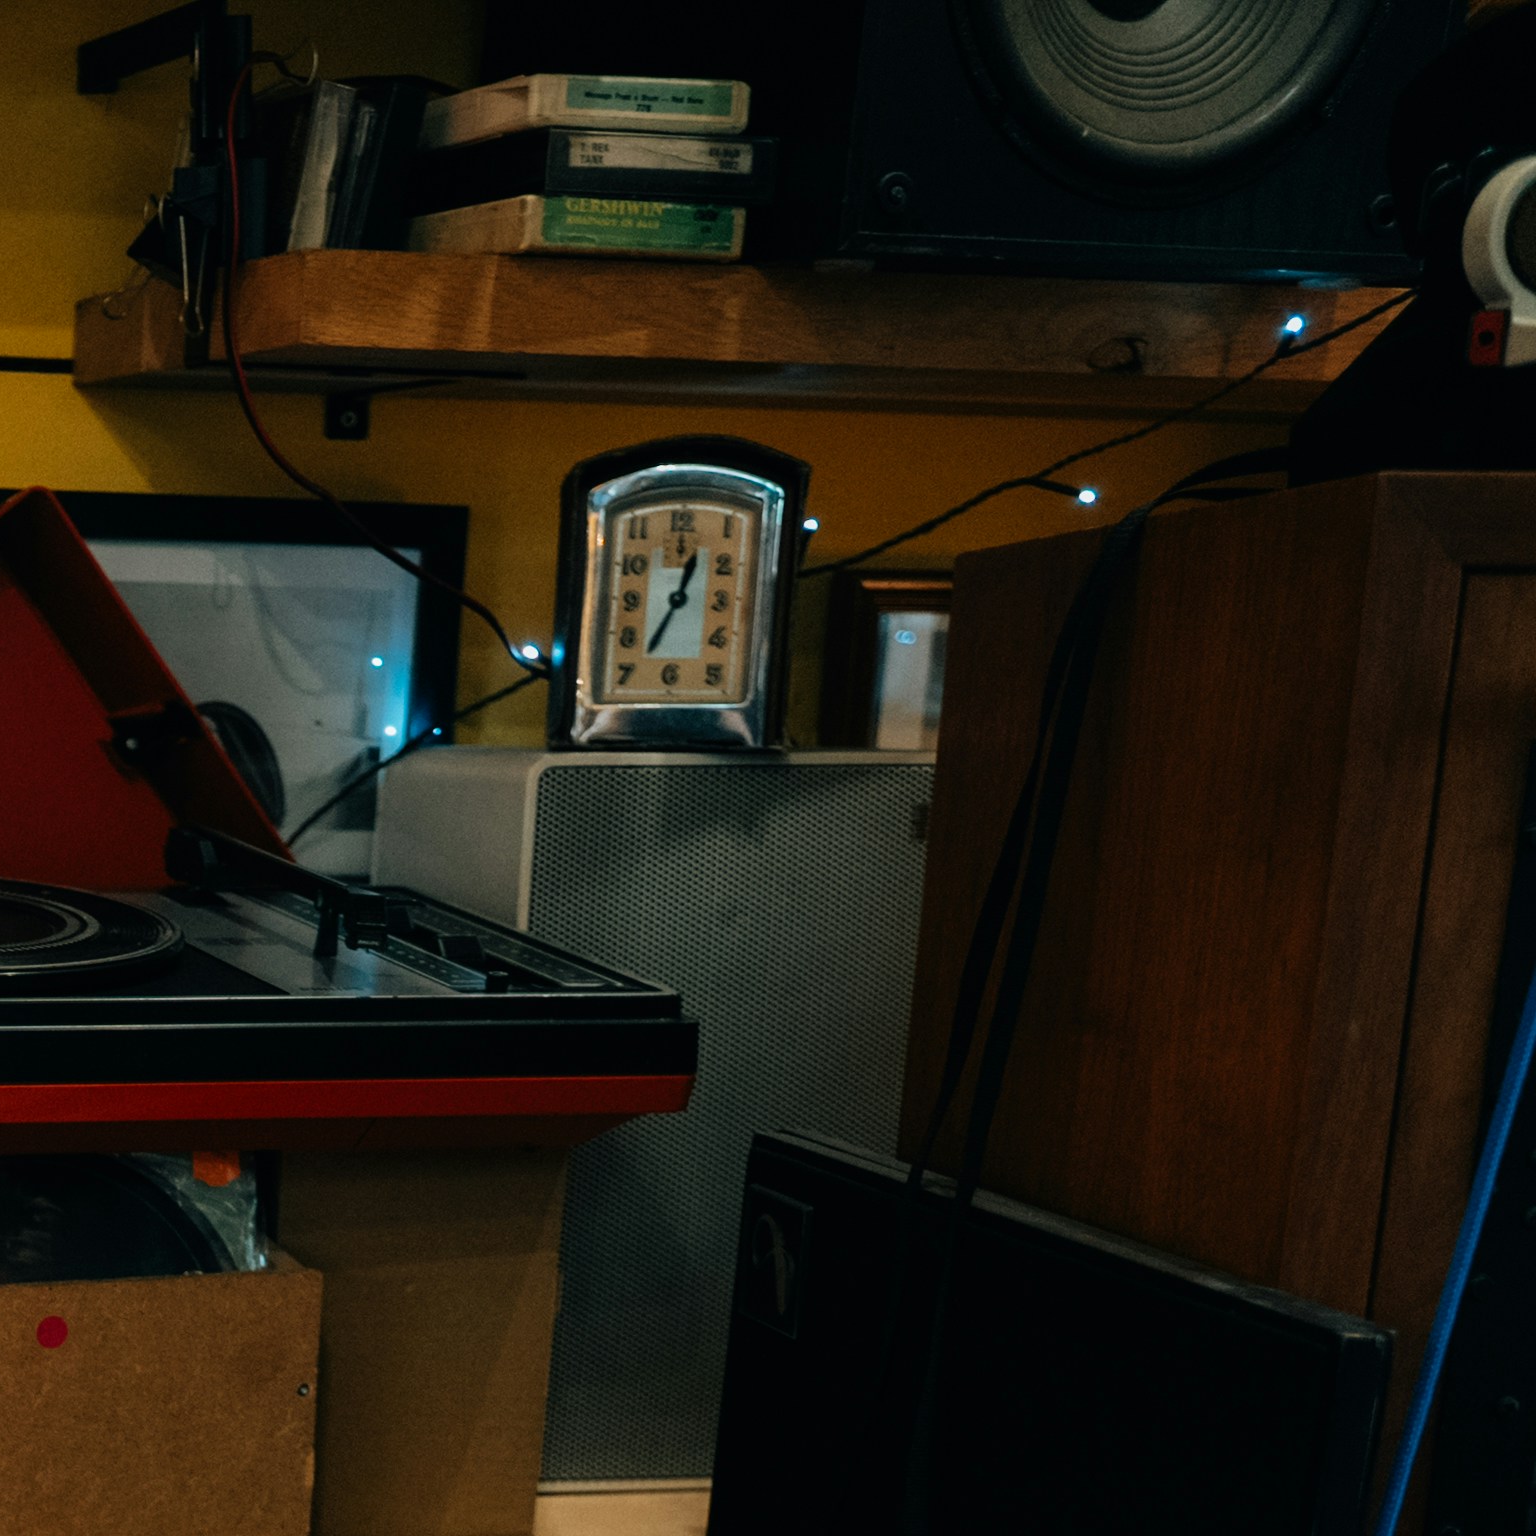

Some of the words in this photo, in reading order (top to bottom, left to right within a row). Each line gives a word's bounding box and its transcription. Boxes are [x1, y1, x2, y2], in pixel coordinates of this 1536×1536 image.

[565, 198, 665, 216] GERSHWIN
[628, 516, 648, 539] 11
[670, 511, 695, 532] 12
[722, 515, 733, 538] 1
[622, 553, 648, 575] 10
[715, 553, 733, 575] 2
[619, 625, 637, 648] 8
[617, 663, 635, 685] 7
[661, 663, 679, 685] 6
[705, 663, 723, 685] 5
